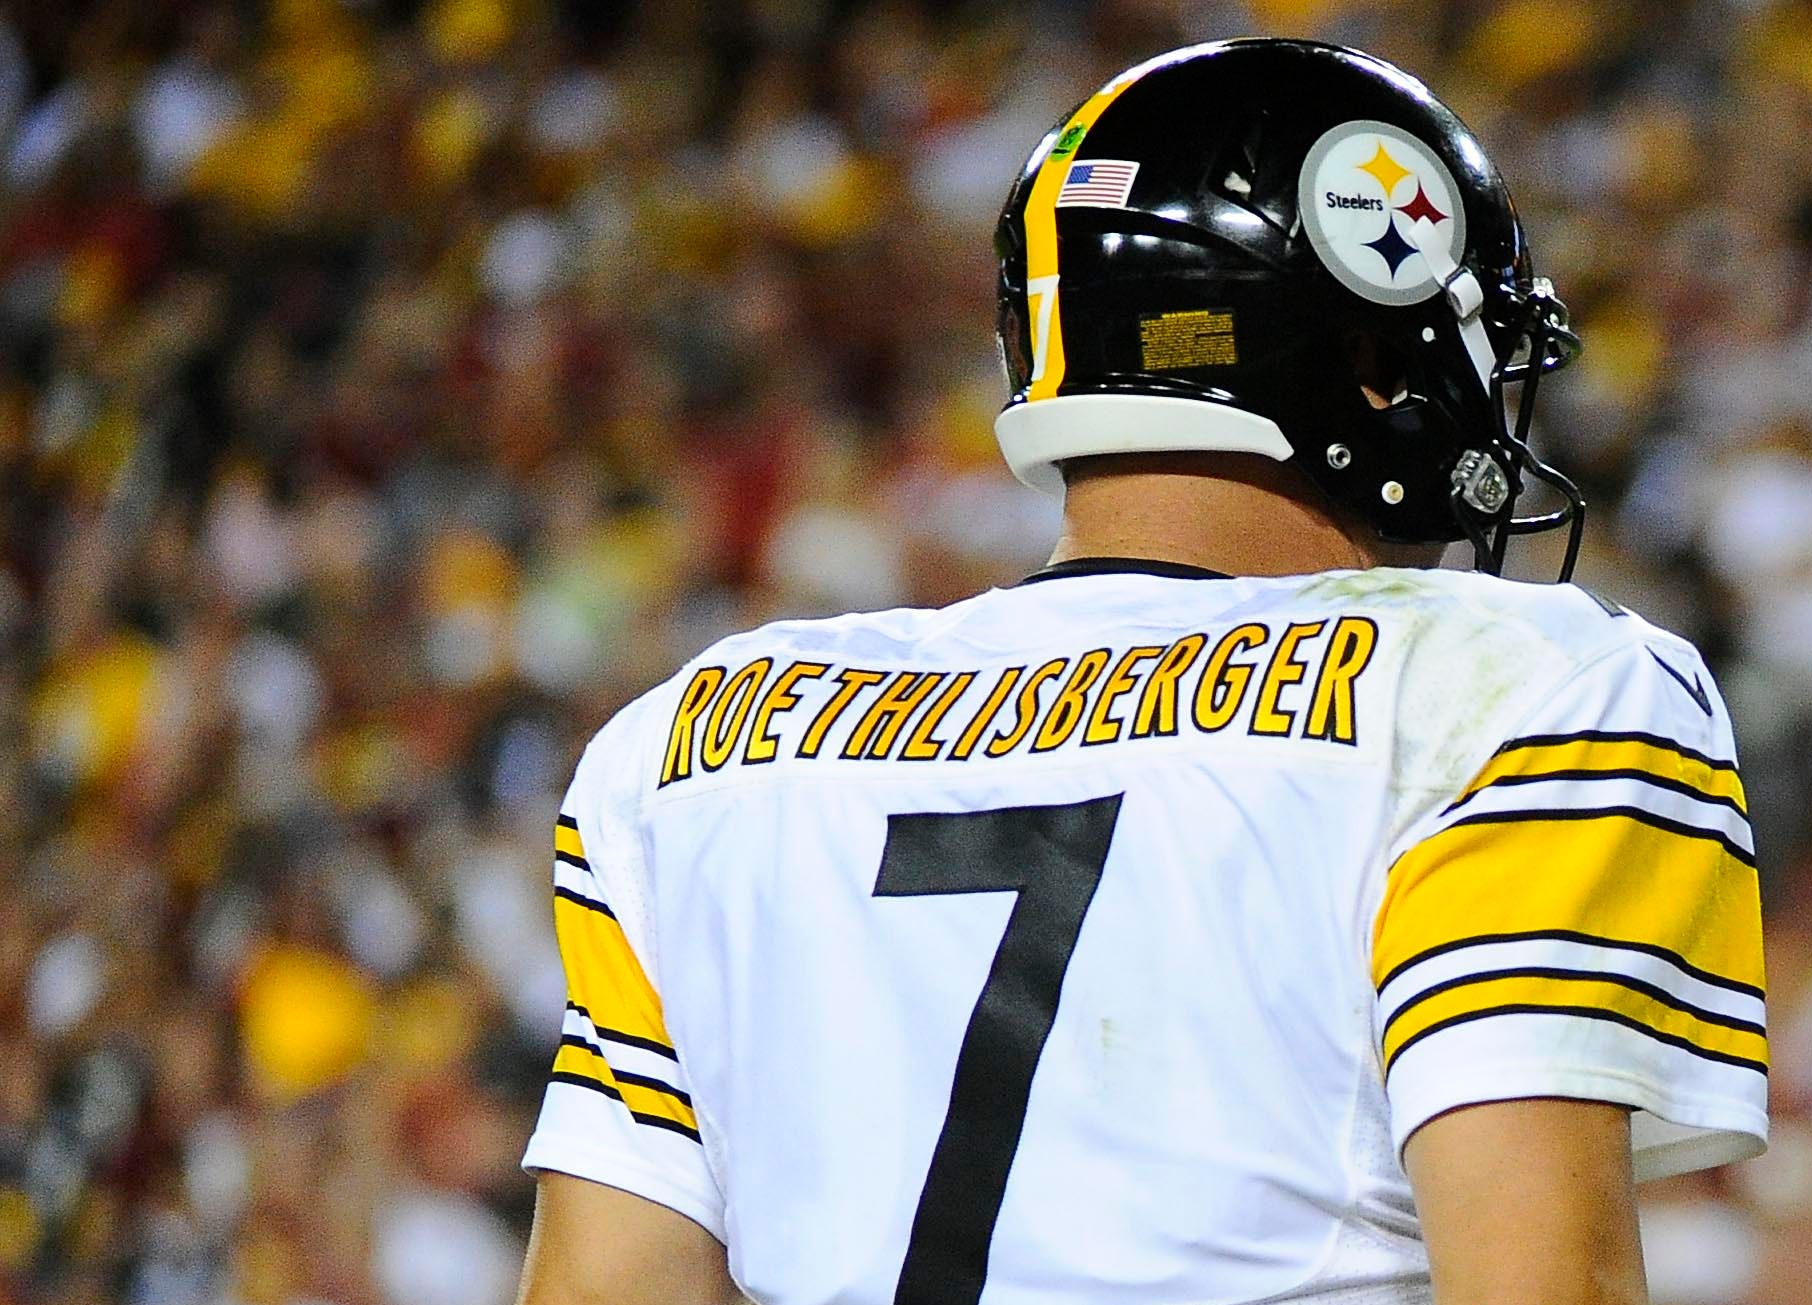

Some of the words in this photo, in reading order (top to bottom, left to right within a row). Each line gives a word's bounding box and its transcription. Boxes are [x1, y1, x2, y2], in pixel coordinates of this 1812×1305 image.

[1326, 192, 1384, 212] Steelers
[1026, 274, 1061, 382] 7
[657, 616, 1380, 790] ROETHLISBERGER
